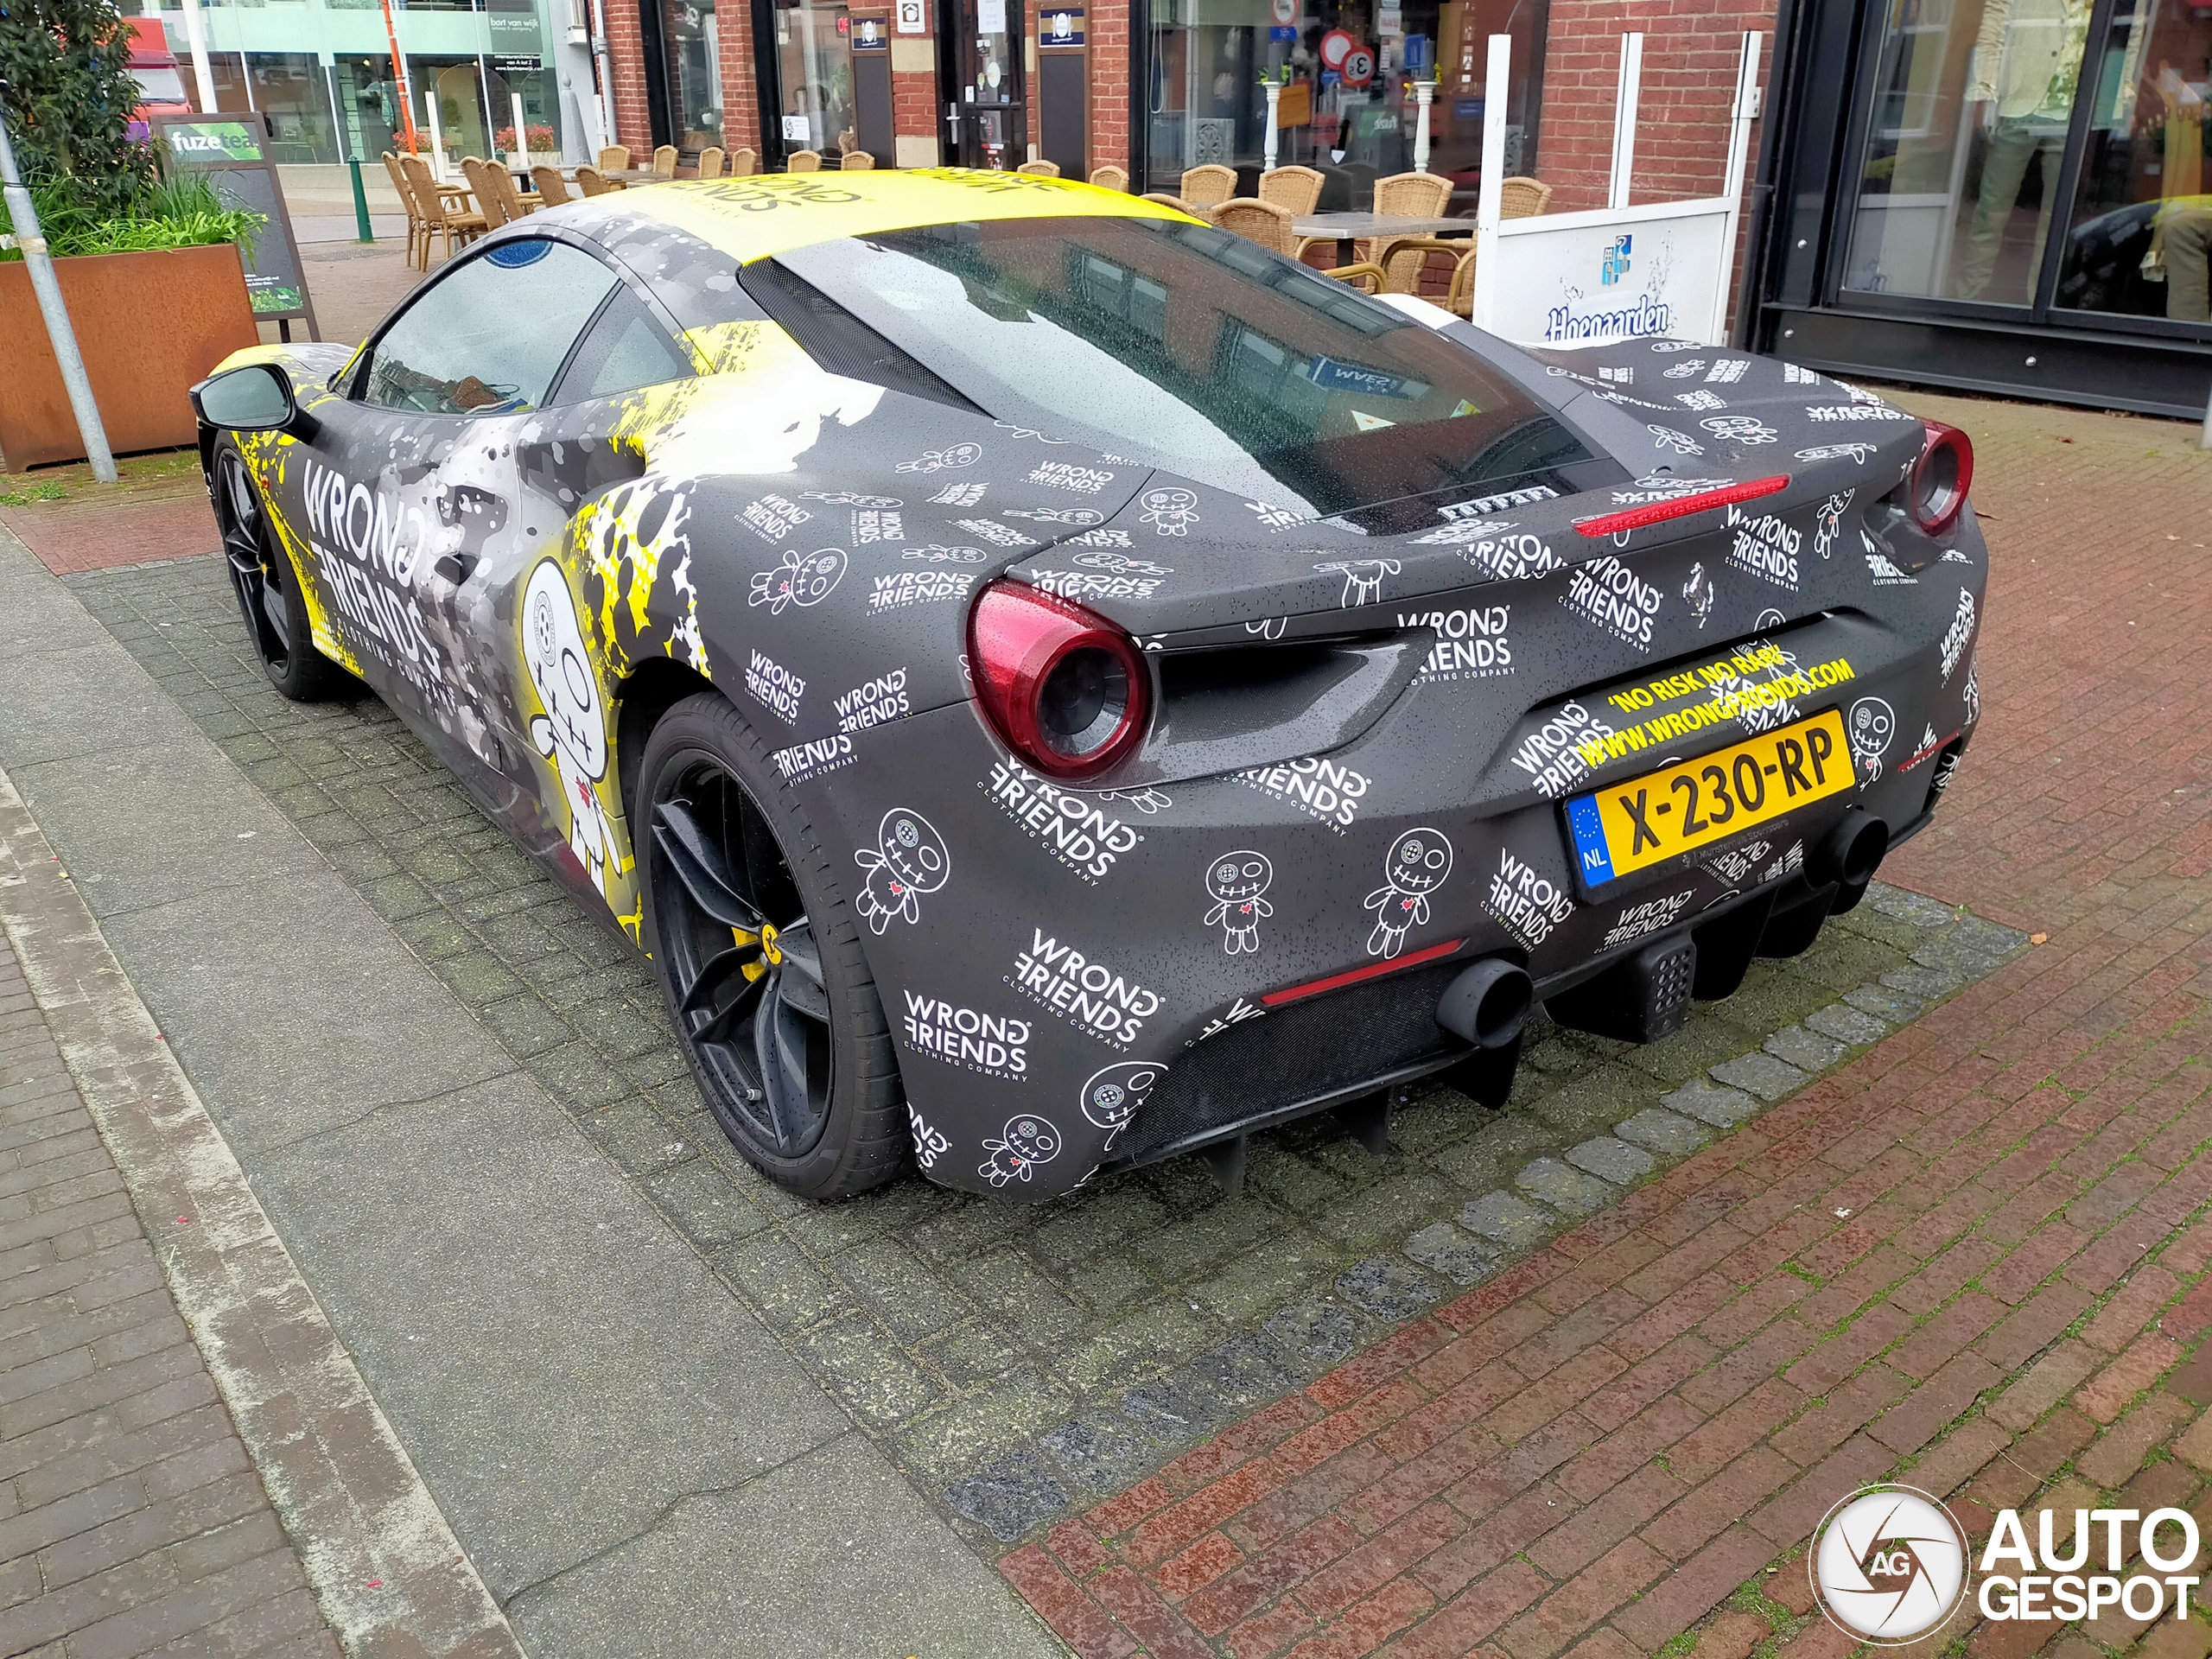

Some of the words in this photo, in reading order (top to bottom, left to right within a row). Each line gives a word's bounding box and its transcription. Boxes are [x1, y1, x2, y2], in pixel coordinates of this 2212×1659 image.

[490, 17, 506, 26] bart
[523, 18, 539, 29] wijk
[1027, 469, 1105, 492] FRIENDS
[1040, 461, 1115, 482] WRONG
[304, 458, 427, 588] WRONG
[734, 514, 757, 532] CLOTHING
[742, 501, 792, 539] FRIENDS
[760, 493, 811, 524] WRONG
[857, 510, 881, 544] FRIENDS
[880, 512, 906, 541] WRONG
[1438, 486, 1560, 522] Ferrari
[1728, 503, 1800, 556] WRONG
[1031, 569, 1161, 587] WRONG
[1725, 556, 1761, 578] CLOTHING
[1764, 573, 1799, 593] COMPANY
[1732, 530, 1798, 582] FRIENDS
[868, 583, 969, 608] FRIENDS
[874, 571, 975, 591] WRONG
[1586, 556, 1661, 614] WRONG
[309, 539, 442, 683] FRIENDS
[866, 601, 913, 617] CLOTHING
[919, 595, 968, 604] COMPANY
[1558, 595, 1604, 627] CLOTHING
[1607, 626, 1650, 654] COMPANY
[1568, 569, 1654, 644] FRIENDS
[1940, 589, 1974, 658] WRONG
[337, 617, 393, 667] CLOTHING
[397, 658, 456, 710] COMPANY
[751, 648, 804, 698] WRONG
[1411, 672, 1458, 686] OTHING
[1465, 667, 1516, 679] COMPANY
[1649, 671, 1707, 702] RISK
[1698, 661, 1737, 686] NO
[744, 687, 768, 709] CLOTHING
[770, 707, 797, 728] COMPANY
[745, 668, 799, 719] FRIENDS
[833, 670, 906, 717] WRONG
[838, 691, 910, 734] FRIENDS
[1577, 658, 1856, 767] WWW.WRONGFRIENDS.COM
[772, 734, 852, 779] FRIENDS
[1510, 703, 1589, 774] WRONG
[789, 771, 813, 788] OTHING
[817, 754, 859, 775] COMPANY
[1289, 758, 1367, 798] ONG
[1618, 727, 1833, 856] X-230-RP
[989, 761, 1116, 877] FRIENDS
[1007, 754, 1137, 853] WRONG
[1290, 799, 1348, 837] COMPANY
[976, 781, 1037, 838] CLOTHING
[1041, 842, 1099, 887] COMPANY
[1583, 848, 1608, 870] NL
[1500, 847, 1574, 924] WRONG
[1618, 890, 1694, 927] WRONG
[1480, 899, 1514, 932] CLOTHING
[1511, 930, 1535, 954] COMPANY
[1490, 874, 1554, 945] FRIENDS
[1603, 909, 1681, 946] FRIENDS
[1032, 927, 1160, 1017] WRONG
[904, 989, 1030, 1046] WRONG
[1002, 975, 1064, 1019] CLOTHING
[1070, 1019, 1130, 1054] COMPANY
[1014, 951, 1143, 1043] FRIENDS
[904, 1015, 1027, 1073] FRIENDS
[904, 1040, 960, 1067] CLOTHING
[967, 1063, 1028, 1083] COMPANY
